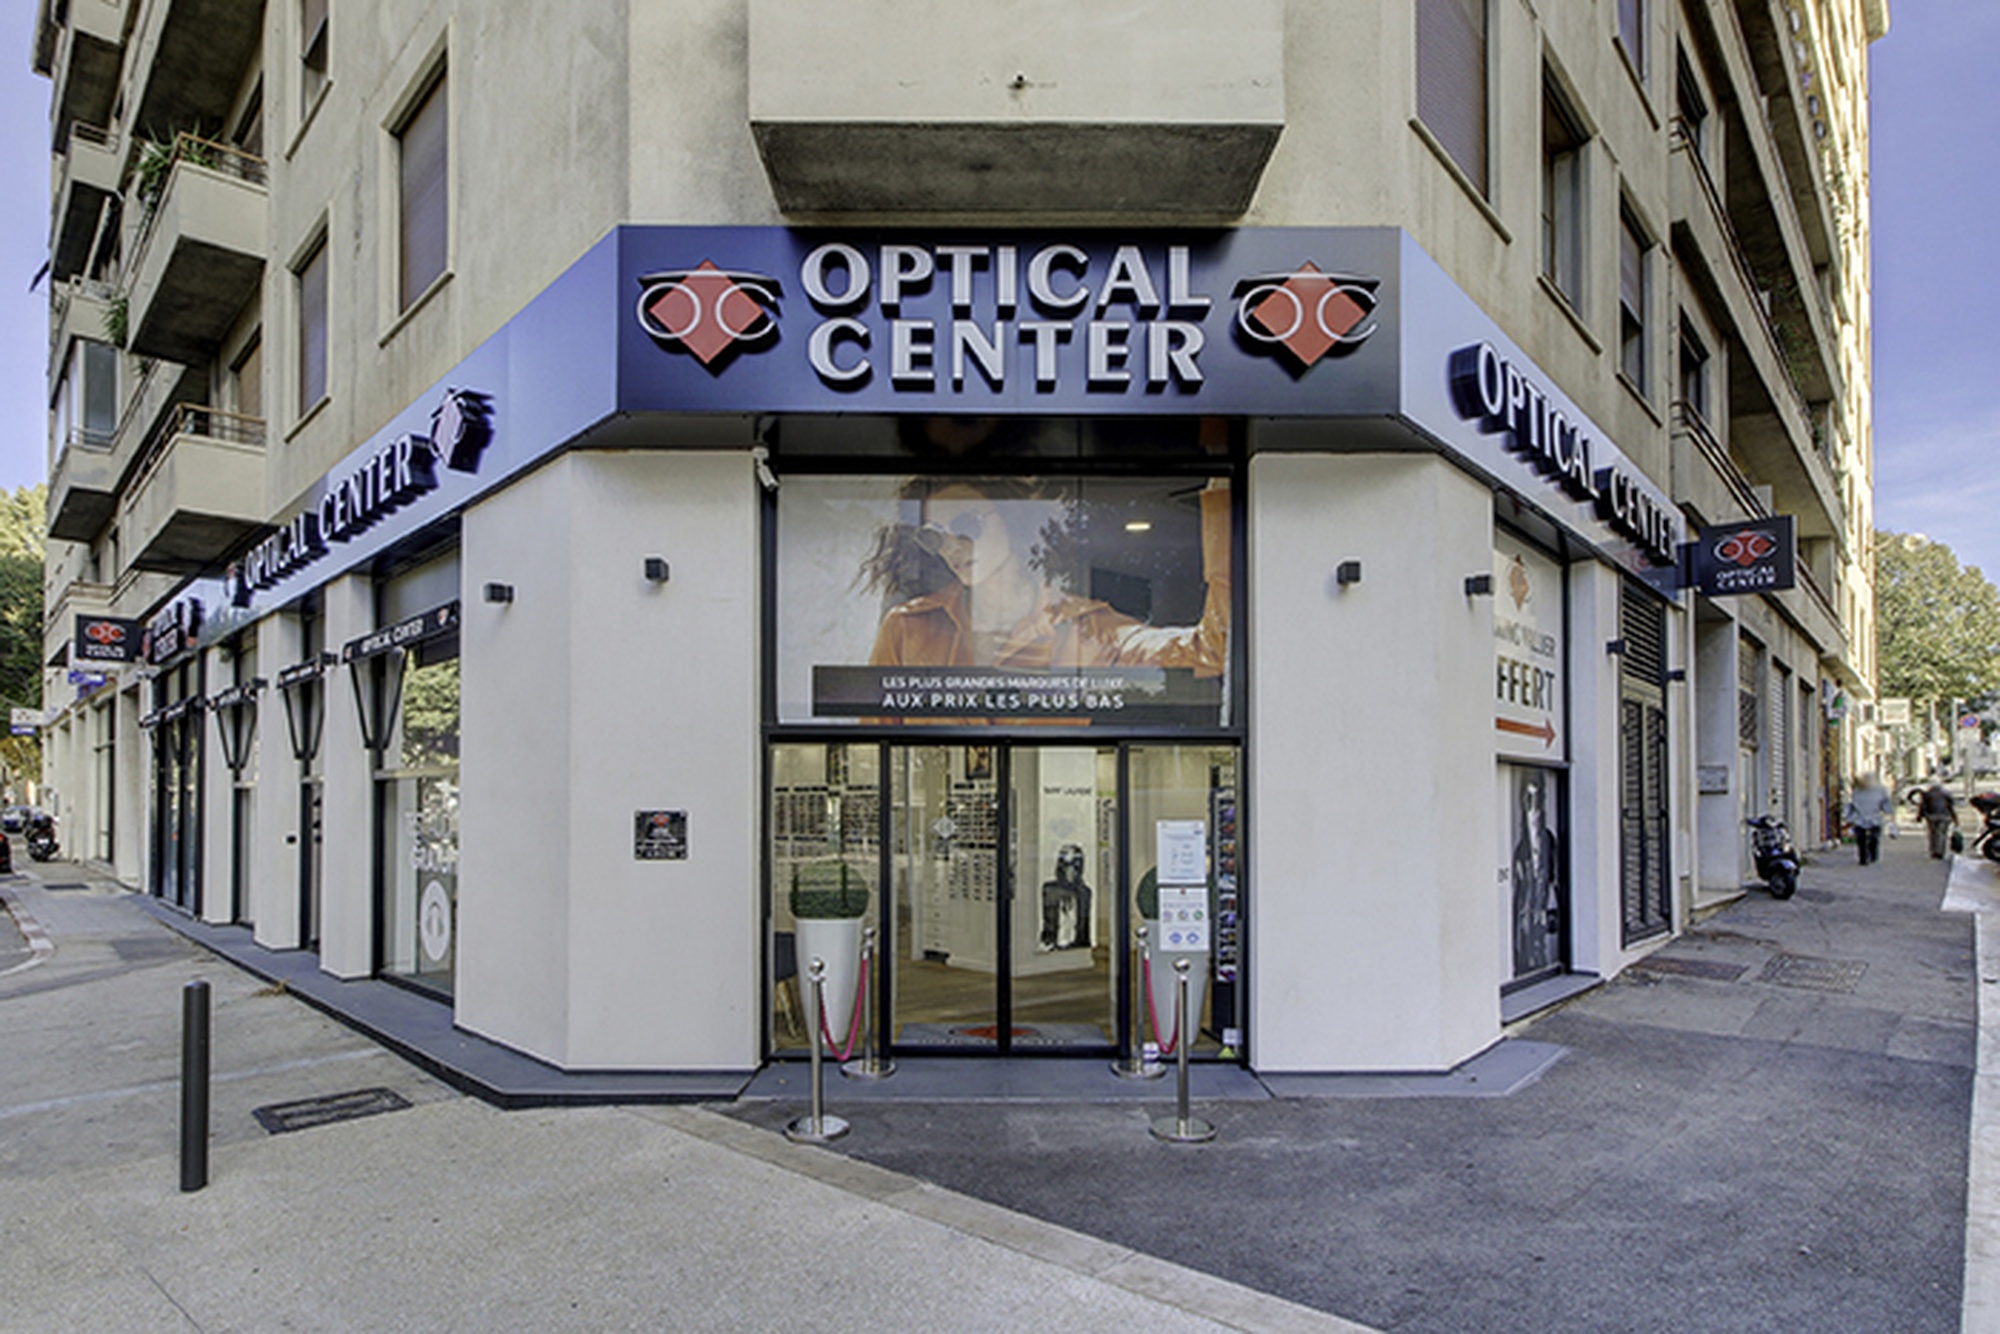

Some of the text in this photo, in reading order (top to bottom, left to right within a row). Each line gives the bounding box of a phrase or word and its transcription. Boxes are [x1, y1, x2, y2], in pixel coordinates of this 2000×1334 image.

[801, 243, 1211, 309] OPTICAL
[808, 317, 1205, 382] CENTER
[1477, 342, 1679, 566] OPTICAL CENTER
[319, 433, 412, 541] CENTER
[882, 677, 906, 689] LES
[908, 677, 942, 689] PLUS
[945, 677, 1003, 689] GRANDES
[882, 693, 1125, 709] AUX PRIX LES PLUS BAS
